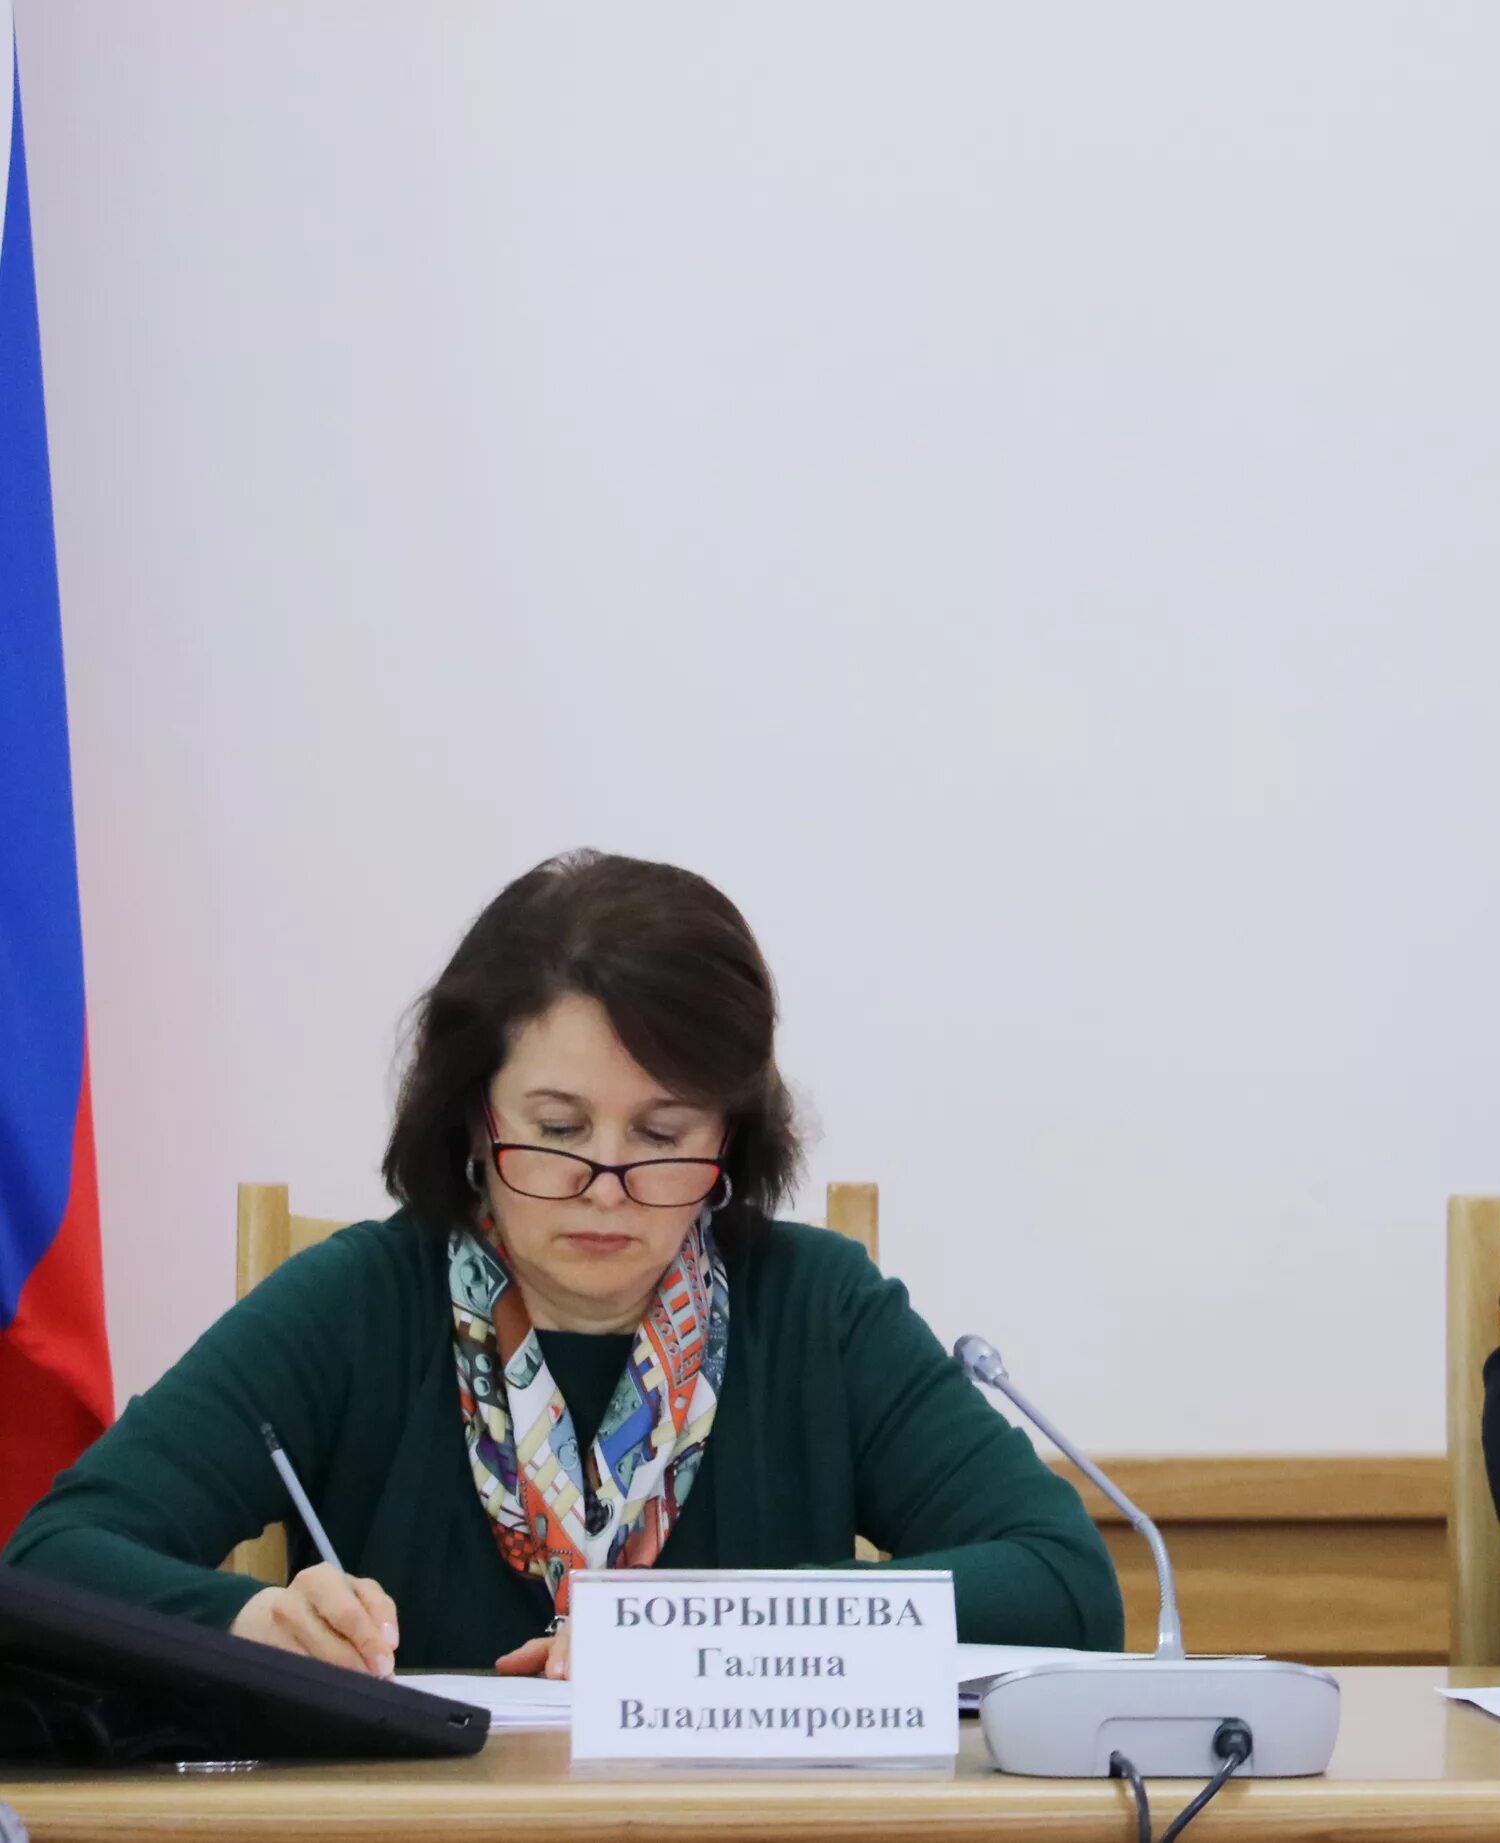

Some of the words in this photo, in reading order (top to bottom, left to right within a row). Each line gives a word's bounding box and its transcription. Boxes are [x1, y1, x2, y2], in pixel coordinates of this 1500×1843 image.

[615, 1596, 924, 1627] БОБРЫШЕВА
[696, 1647, 846, 1678] Галина
[619, 1699, 925, 1737] Владимировна
